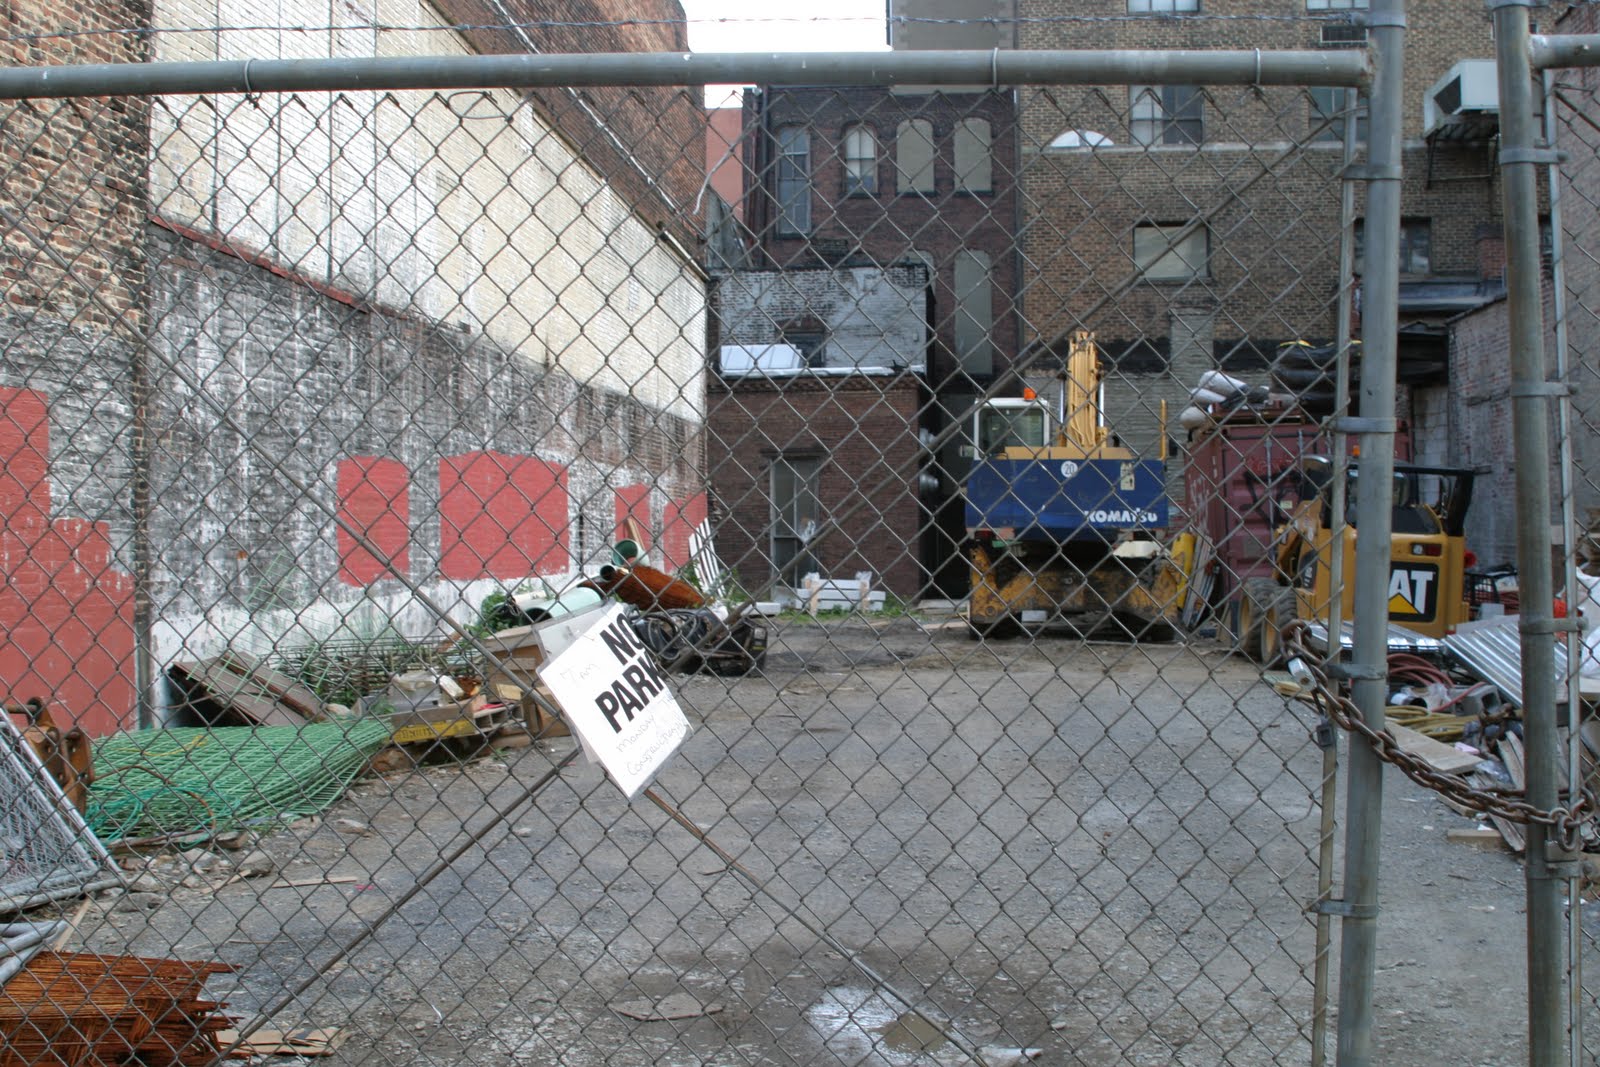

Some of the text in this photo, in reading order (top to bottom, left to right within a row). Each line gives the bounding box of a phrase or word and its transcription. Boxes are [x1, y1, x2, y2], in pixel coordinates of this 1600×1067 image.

[1084, 507, 1158, 523] KOMATSU
[1389, 569, 1434, 614] AT
[600, 613, 646, 666] NO
